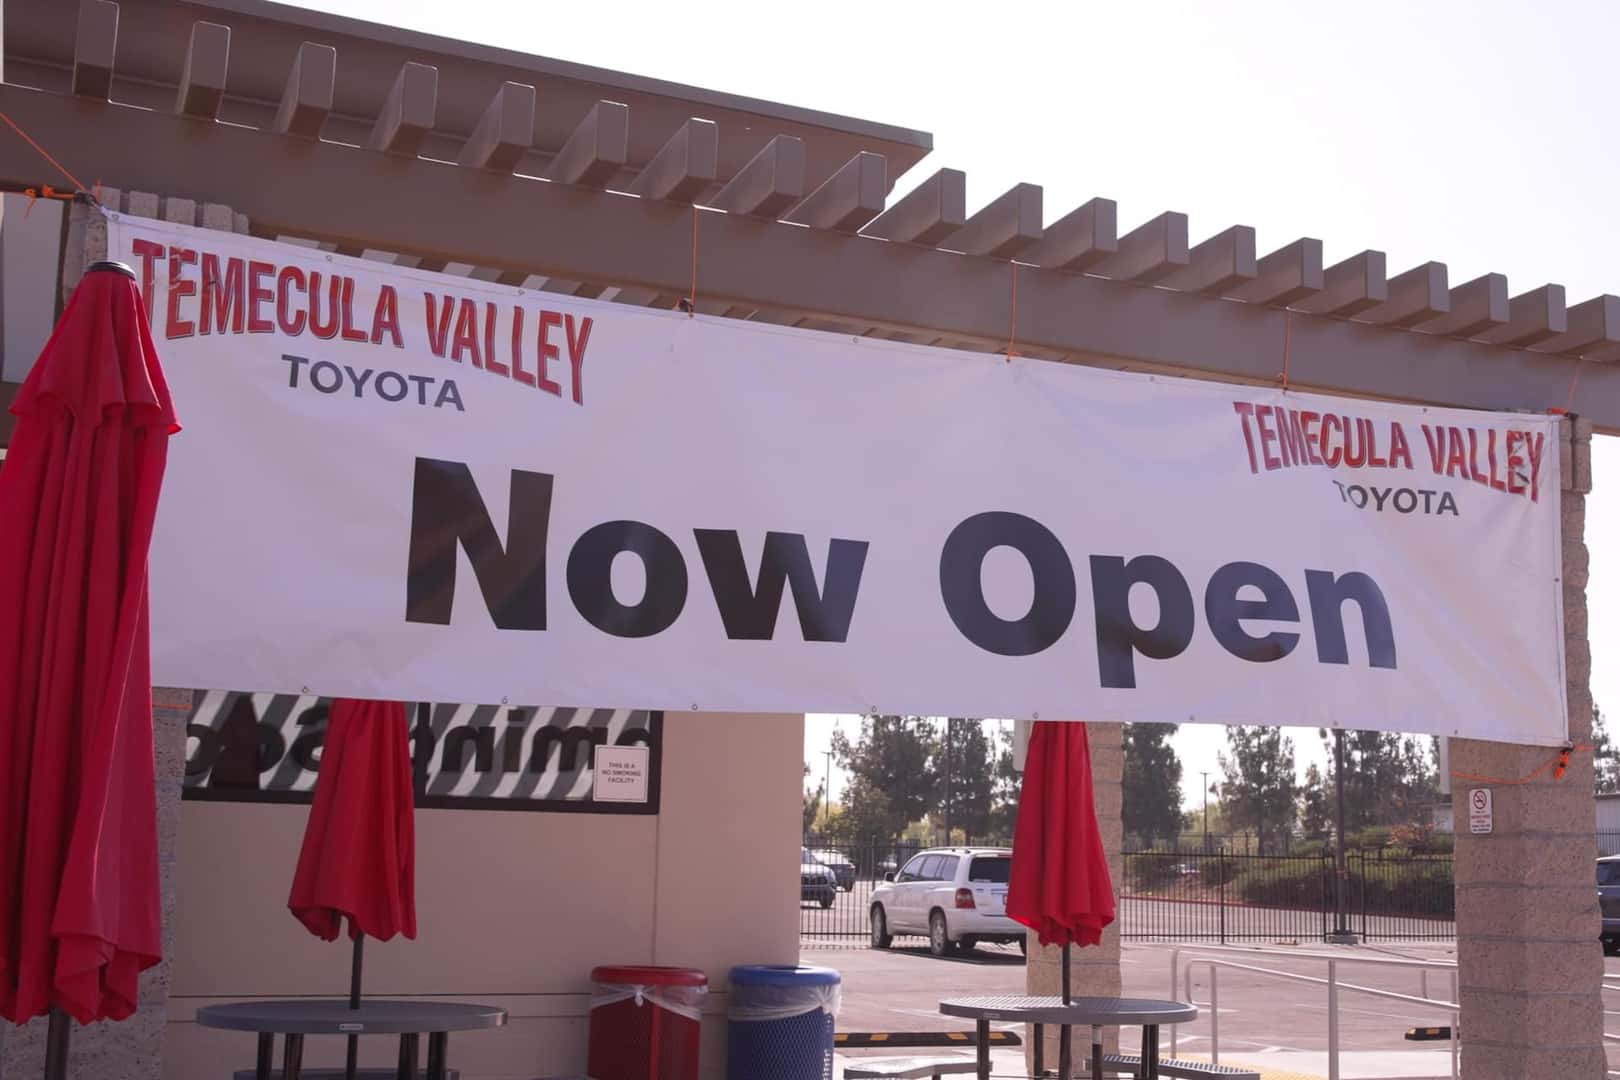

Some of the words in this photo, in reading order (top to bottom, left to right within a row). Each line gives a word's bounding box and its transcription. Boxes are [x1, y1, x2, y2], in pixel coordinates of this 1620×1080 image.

[132, 238, 404, 348] TEMECULA
[423, 291, 593, 406] VALLEY
[281, 353, 466, 411] TOYOTA
[1233, 401, 1414, 474] TEMECULA
[1421, 424, 1544, 504] VALLEY
[1332, 480, 1460, 516] TOYOTA
[405, 456, 870, 643] Now
[939, 510, 1397, 689] Open
